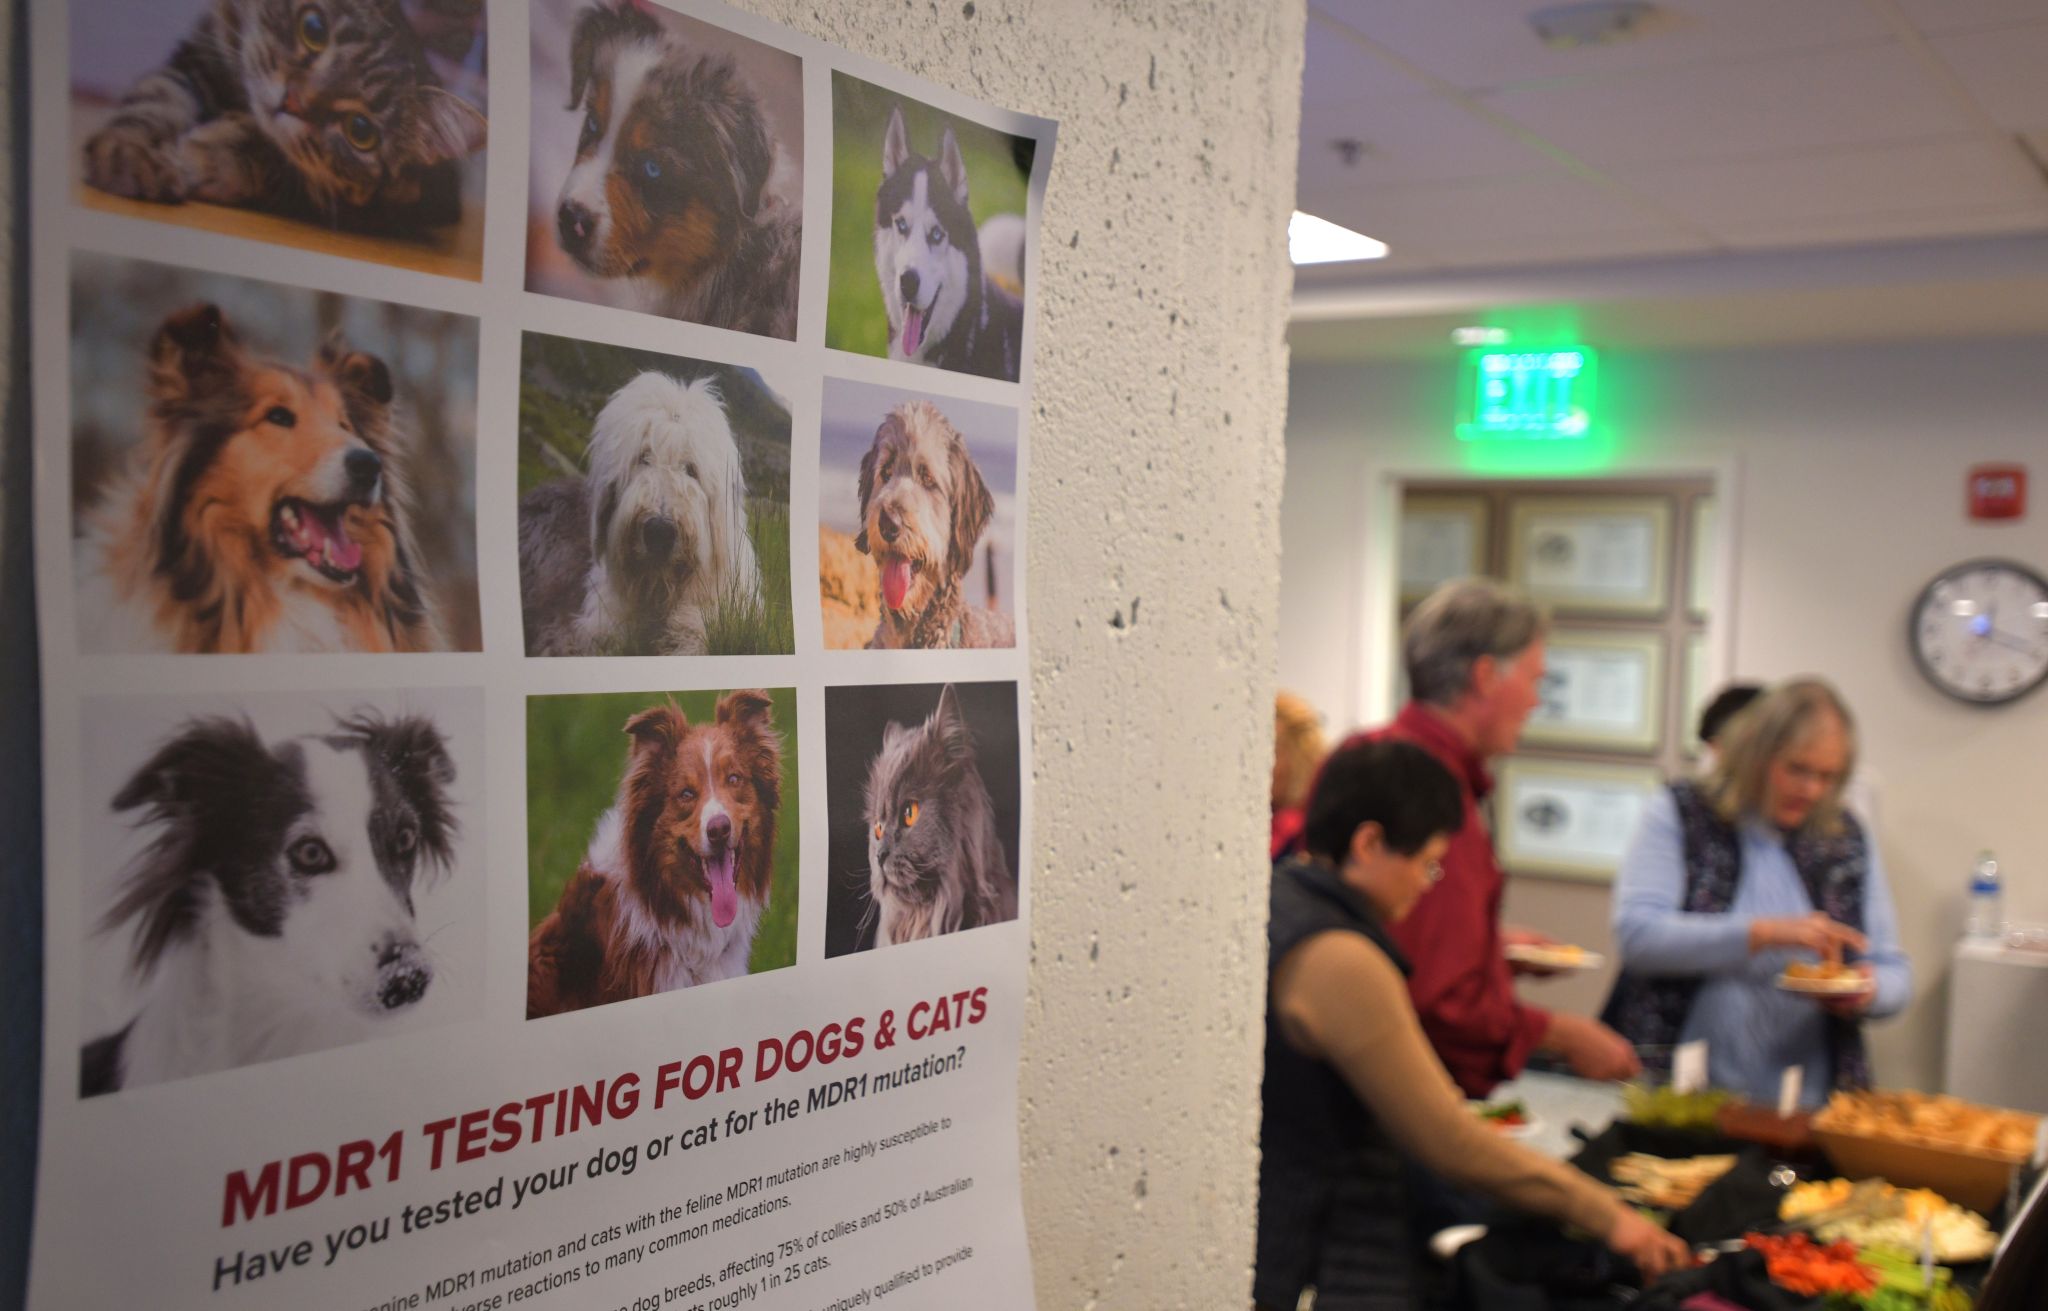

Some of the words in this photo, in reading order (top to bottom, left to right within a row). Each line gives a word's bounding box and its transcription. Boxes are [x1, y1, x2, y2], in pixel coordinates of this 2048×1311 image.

[213, 1240, 313, 1291] Have
[324, 1217, 390, 1266] you
[402, 1177, 504, 1234] tested
[511, 1161, 578, 1209] your
[586, 1148, 638, 1175] dog
[646, 1135, 673, 1160] or
[680, 1118, 717, 1151] cat
[725, 1109, 757, 1137] for
[764, 1098, 799, 1126] the
[806, 1073, 867, 1114] MDR1
[872, 1046, 966, 1094] mutation?
[221, 1131, 404, 1228] MDR1
[423, 1072, 641, 1171] TESTING
[654, 1047, 743, 1110] FOR
[754, 1017, 865, 1083] DOGS
[874, 1009, 896, 1050] &
[906, 986, 988, 1040] CATS
[362, 1293, 420, 1311] nine
[425, 1270, 475, 1303] MDR1
[481, 1248, 552, 1285] mutation
[557, 1233, 586, 1258] and
[591, 1225, 621, 1247] cats
[626, 1212, 655, 1237] with
[660, 1204, 682, 1224] the
[686, 1191, 722, 1216] feline
[727, 1175, 763, 1202] MDR1
[766, 1160, 818, 1189] mutation
[822, 1153, 840, 1170] are
[844, 1140, 876, 1163] highly
[880, 1121, 938, 1150] susceptible
[941, 1116, 951, 1129] to
[507, 1266, 581, 1304] reactions
[586, 1259, 600, 1277] to
[605, 1245, 644, 1270] many
[649, 1223, 708, 1253] common
[712, 1195, 792, 1231] medications.
[632, 1296, 660, 1311] dog
[664, 1274, 716, 1303] breeds,
[719, 1249, 775, 1281] affecting
[777, 1237, 804, 1260] 75%
[806, 1231, 819, 1249] of
[821, 1219, 857, 1243] collies
[860, 1209, 881, 1229] and
[884, 1200, 908, 1220] 50%
[910, 1192, 922, 1210] of
[923, 1177, 974, 1204] Australian
[874, 1265, 920, 1298] qualified
[922, 1262, 934, 1276] to
[935, 1246, 973, 1274] provide
[709, 1282, 757, 1310] roughly
[761, 1277, 767, 1292] 1
[769, 1271, 781, 1289] in
[784, 1263, 800, 1283] 25
[804, 1255, 831, 1275] cats.
